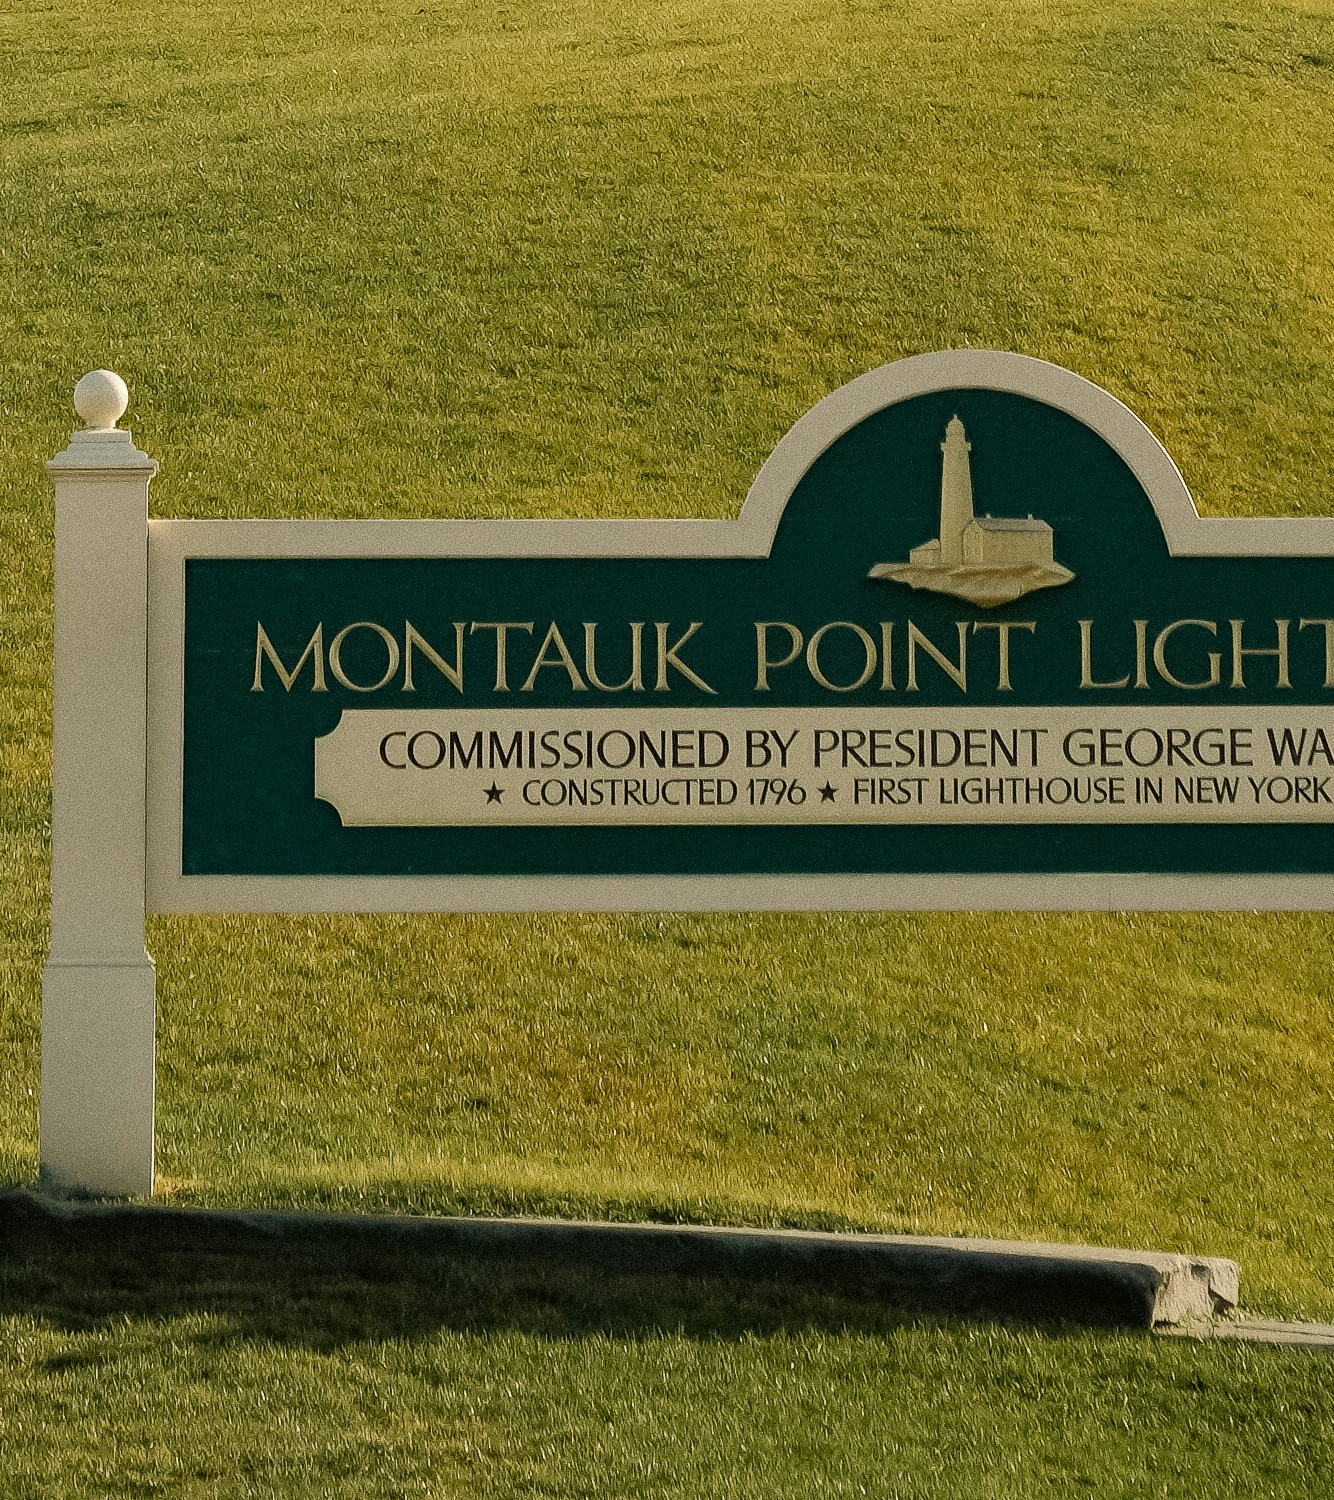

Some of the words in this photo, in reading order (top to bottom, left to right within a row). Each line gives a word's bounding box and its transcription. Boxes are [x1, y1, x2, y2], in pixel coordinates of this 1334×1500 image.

[250, 619, 717, 695] MONTAUK
[754, 619, 1037, 693] POINT
[379, 729, 730, 770] COMMISSIONED
[745, 729, 799, 768] BY
[813, 728, 1049, 768] PRESIDENT
[1062, 727, 1254, 768] GEORGE
[522, 778, 738, 807] CONSTRUCTED
[747, 777, 807, 806] 1796
[853, 777, 930, 805] FIRST
[939, 776, 1126, 805] LIGHTHOUSE
[1135, 776, 1163, 804] IN
[1174, 776, 1240, 804] NEW
[1247, 775, 1333, 805] YORK
